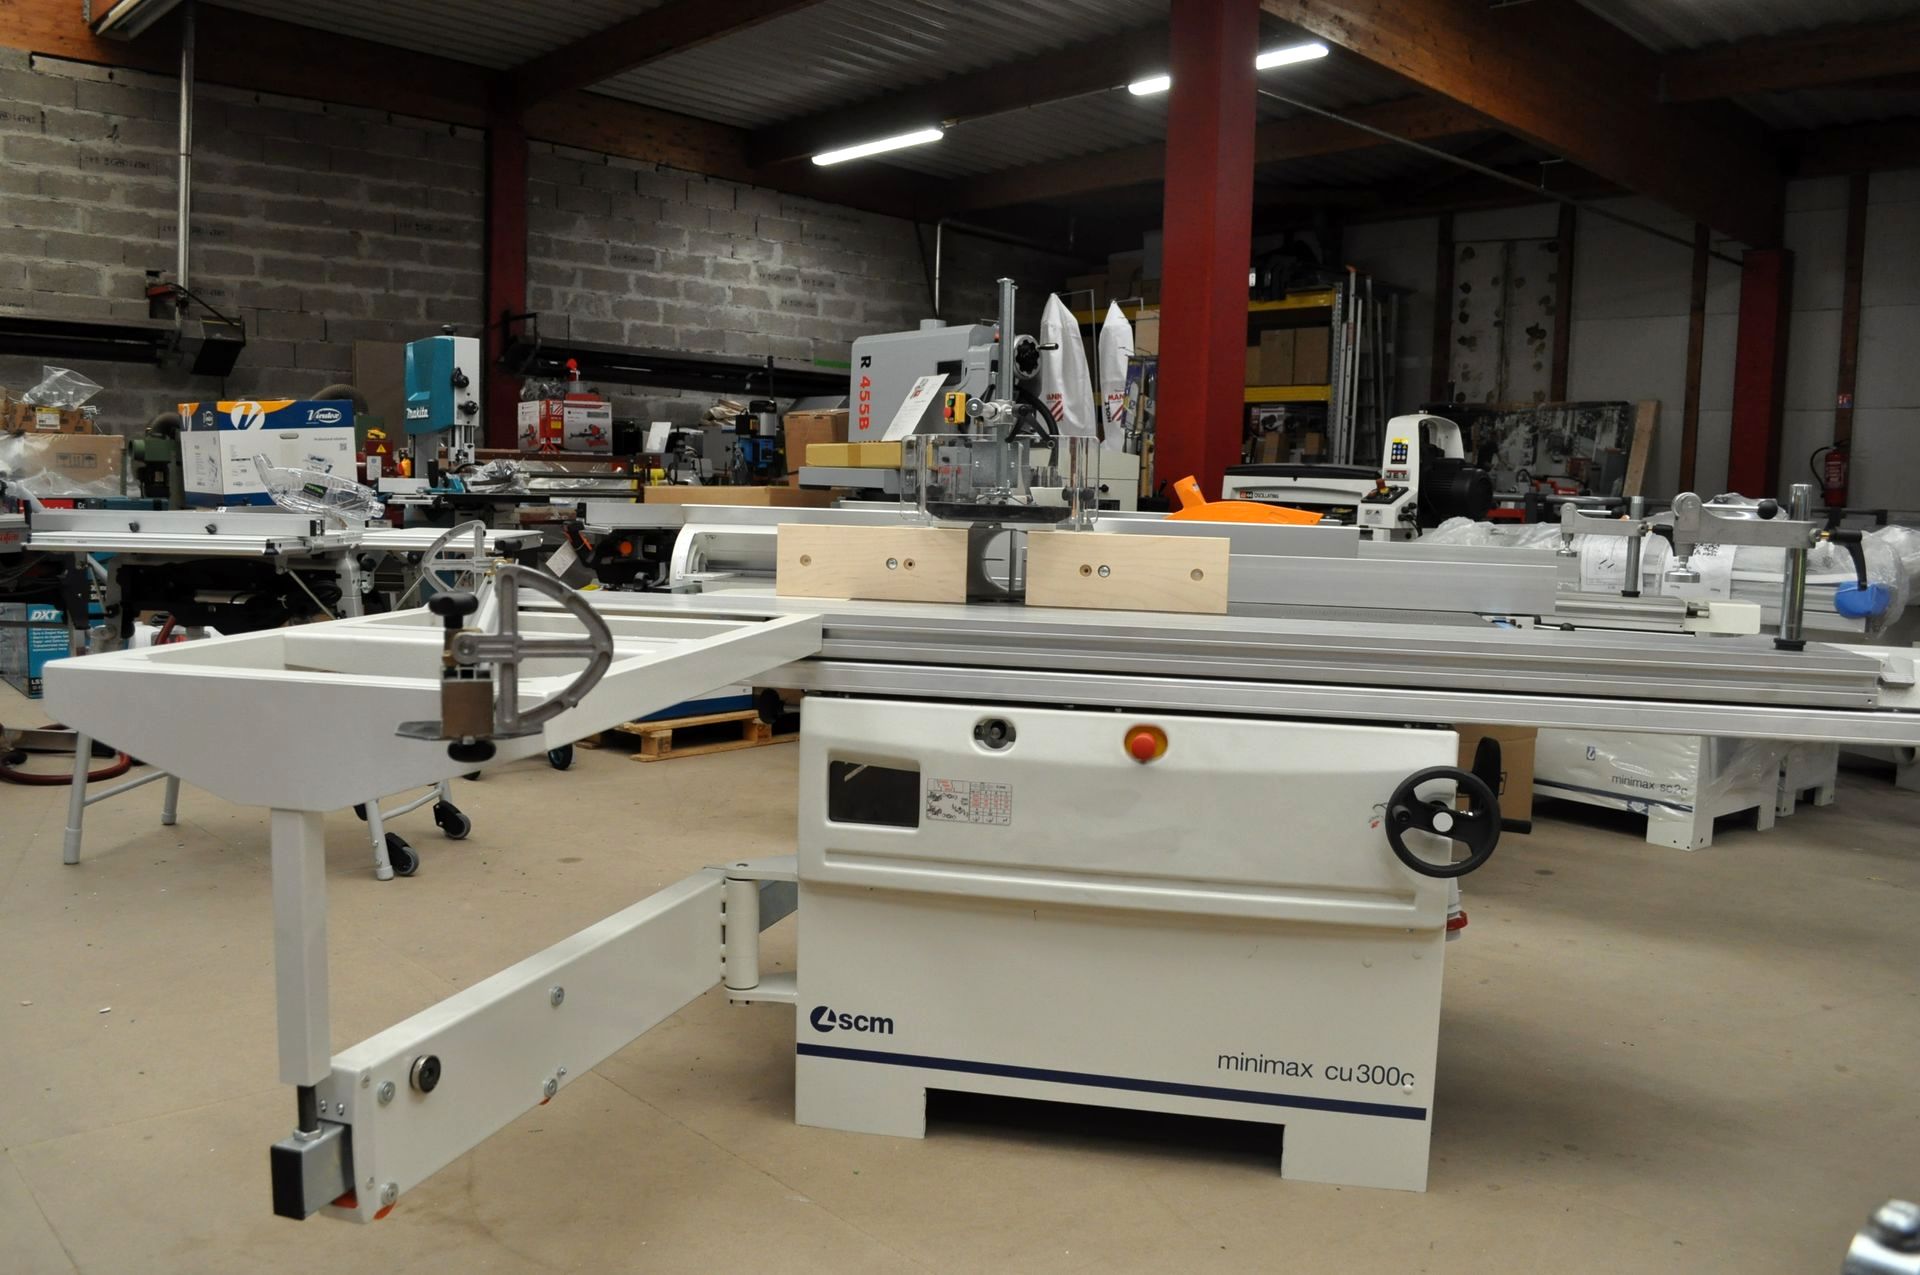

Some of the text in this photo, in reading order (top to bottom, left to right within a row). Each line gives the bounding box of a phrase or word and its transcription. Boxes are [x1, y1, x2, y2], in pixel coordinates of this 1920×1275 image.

[859, 356, 871, 430] R 455B
[1386, 470, 1407, 479] JET
[32, 610, 60, 620] DXT
[1612, 775, 1655, 789] minimax
[838, 1013, 893, 1035] scm
[1217, 1052, 1314, 1078] minimax
